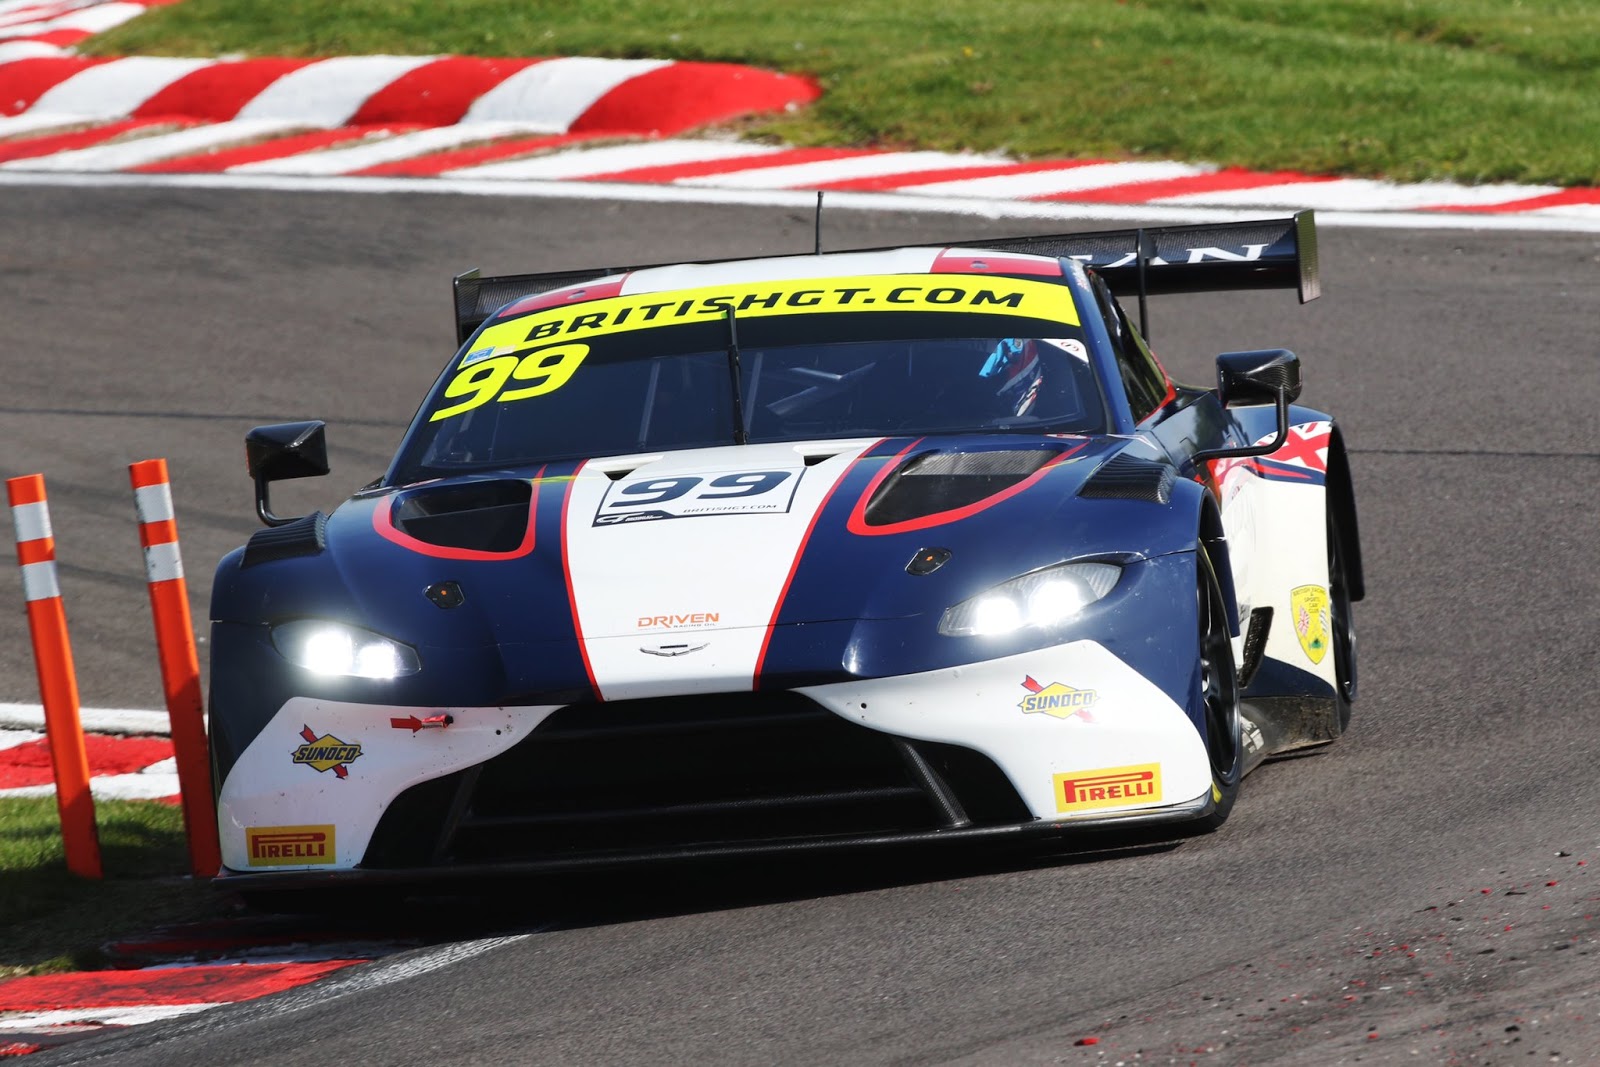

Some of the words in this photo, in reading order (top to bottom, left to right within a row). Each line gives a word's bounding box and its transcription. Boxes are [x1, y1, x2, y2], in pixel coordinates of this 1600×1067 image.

[524, 286, 1025, 343] BRITISHGT.COM
[429, 343, 590, 422] 99
[608, 471, 792, 508] 99
[683, 504, 777, 513] BRITISHGT.COM
[638, 612, 719, 628] DRIVEN
[1025, 692, 1094, 711] SUNOCO
[296, 747, 357, 761] SUNOCO
[1063, 771, 1154, 804] PIRELLI
[251, 832, 326, 858] PIRELLI
